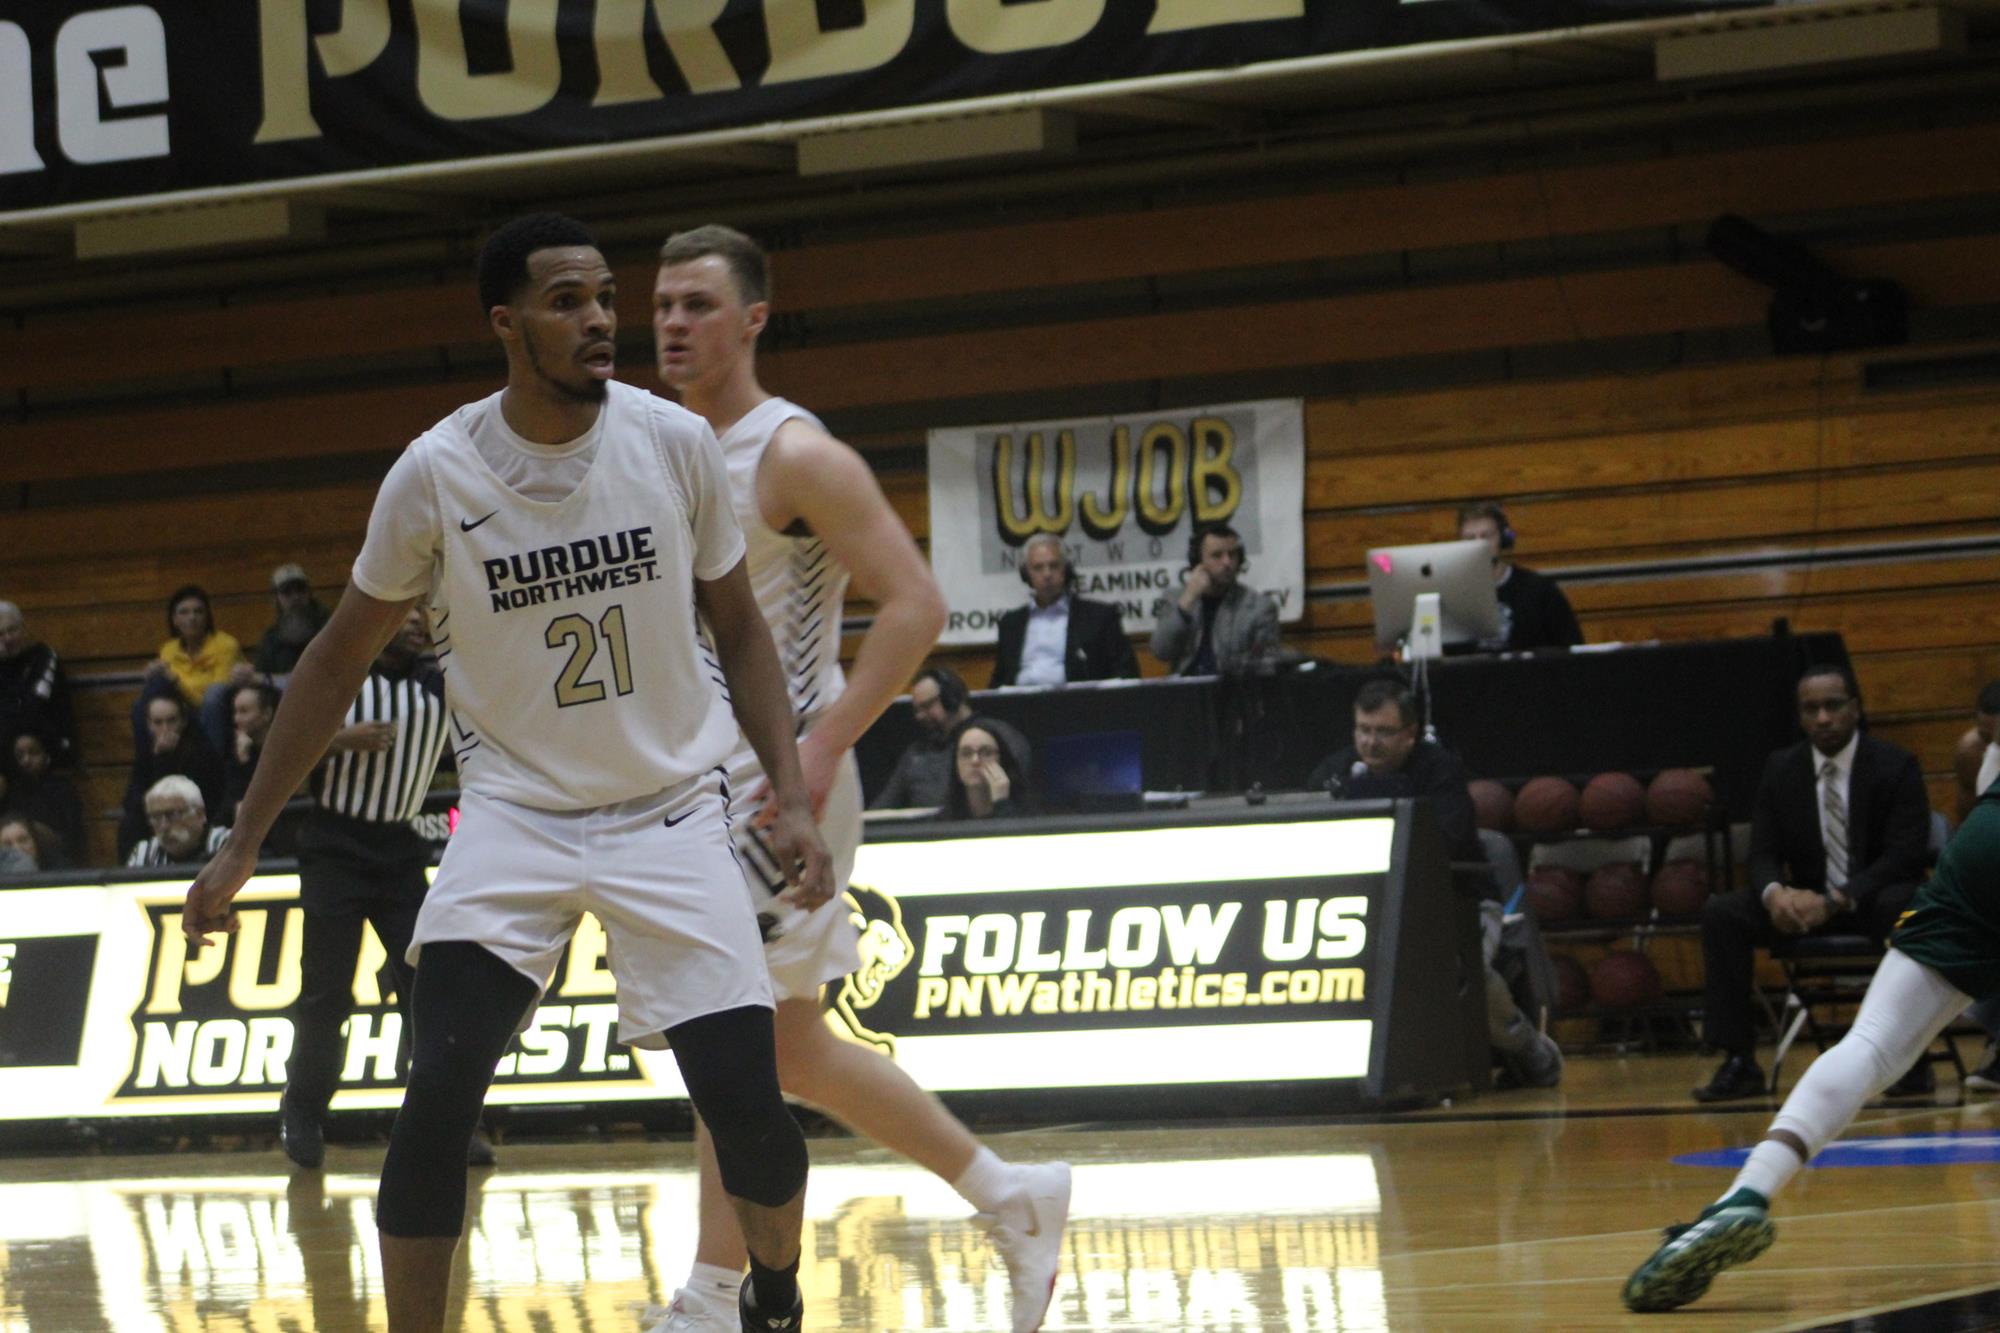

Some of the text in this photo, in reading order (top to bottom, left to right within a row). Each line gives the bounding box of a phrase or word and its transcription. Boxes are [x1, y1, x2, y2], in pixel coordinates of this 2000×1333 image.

[992, 417, 1243, 547] WJOB
[483, 526, 656, 590] PURDUE
[545, 604, 634, 708] 21
[412, 812, 450, 841] OSS
[919, 896, 1369, 977] FOLLOW US
[913, 966, 1366, 1020] PNWathletics.com
